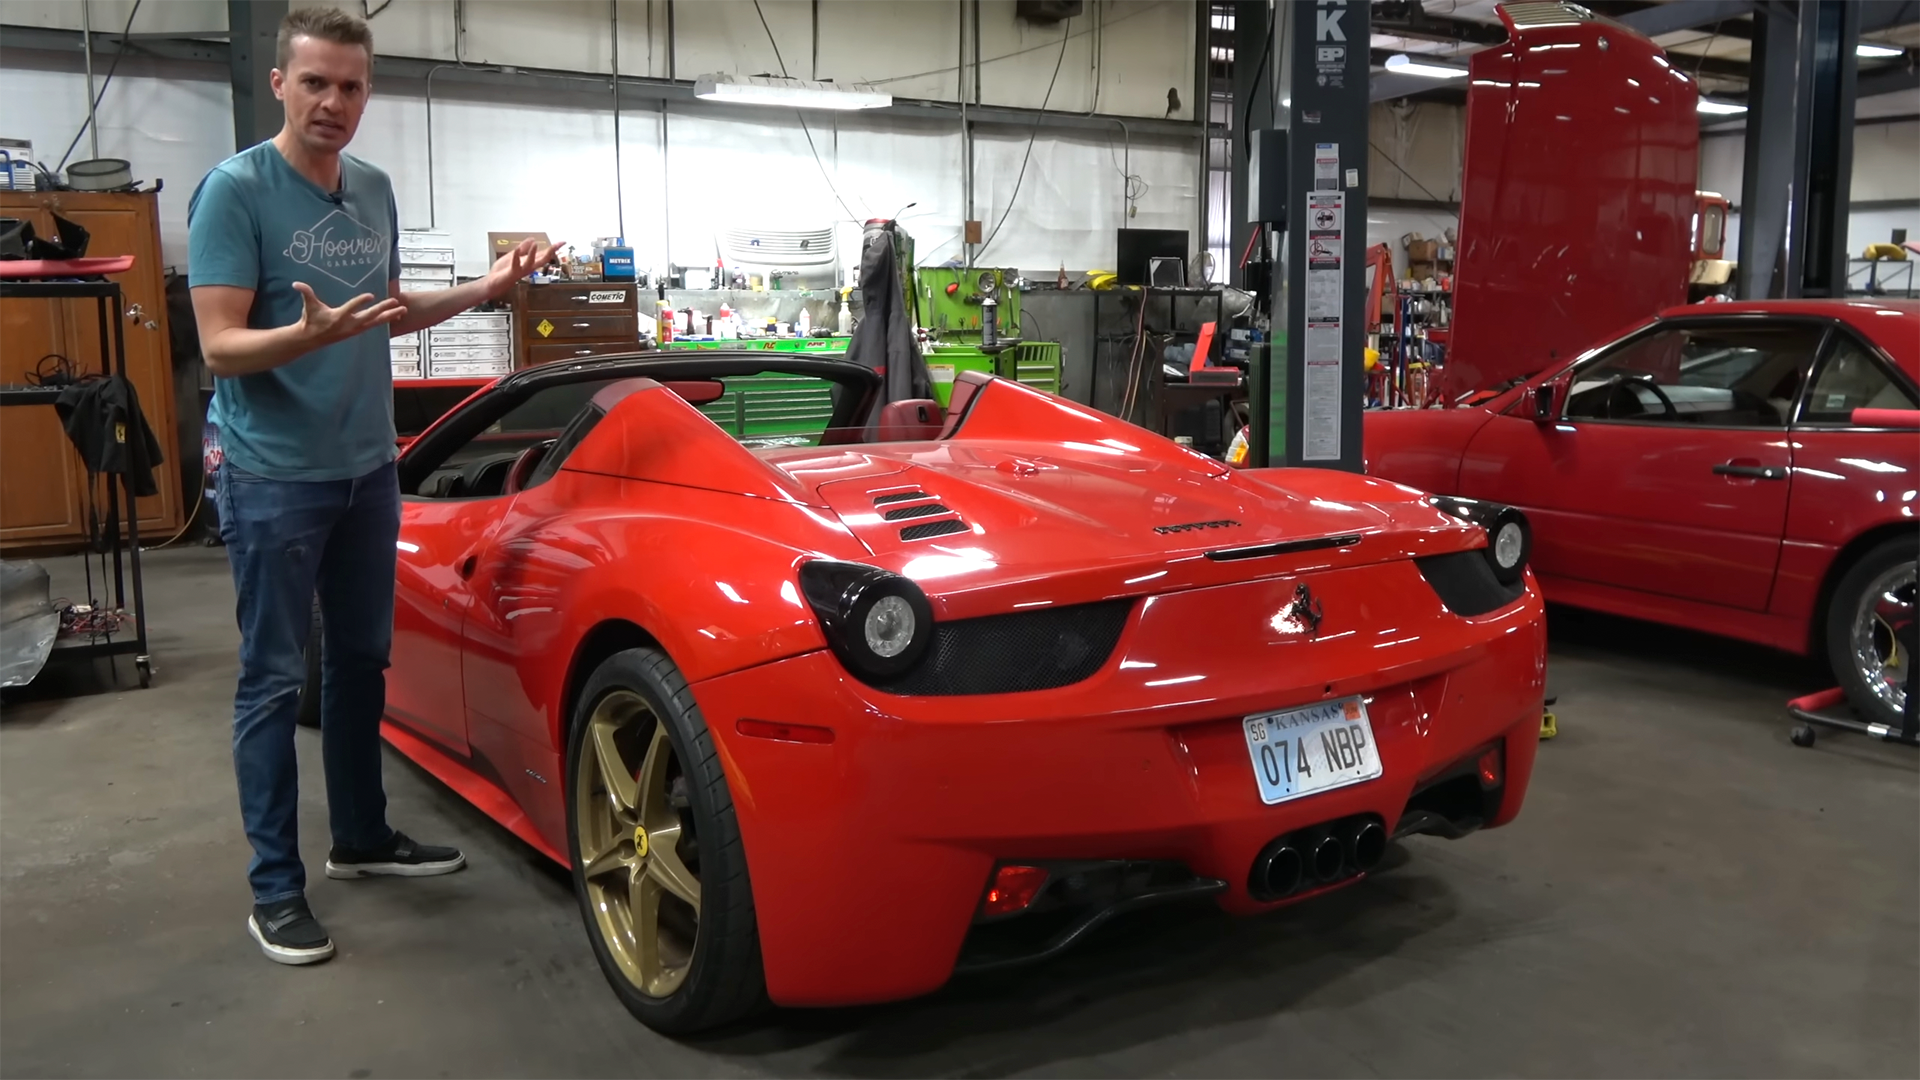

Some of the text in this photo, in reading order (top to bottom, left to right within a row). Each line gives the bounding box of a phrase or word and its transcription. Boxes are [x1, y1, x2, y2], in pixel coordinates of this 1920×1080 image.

[1316, 0, 1347, 41] K
[326, 257, 372, 268] GARAGE
[591, 291, 624, 301] COMETIC
[1275, 702, 1340, 731] KANSAS
[1250, 722, 1266, 741] SG
[1261, 724, 1366, 786] 074 NBP
